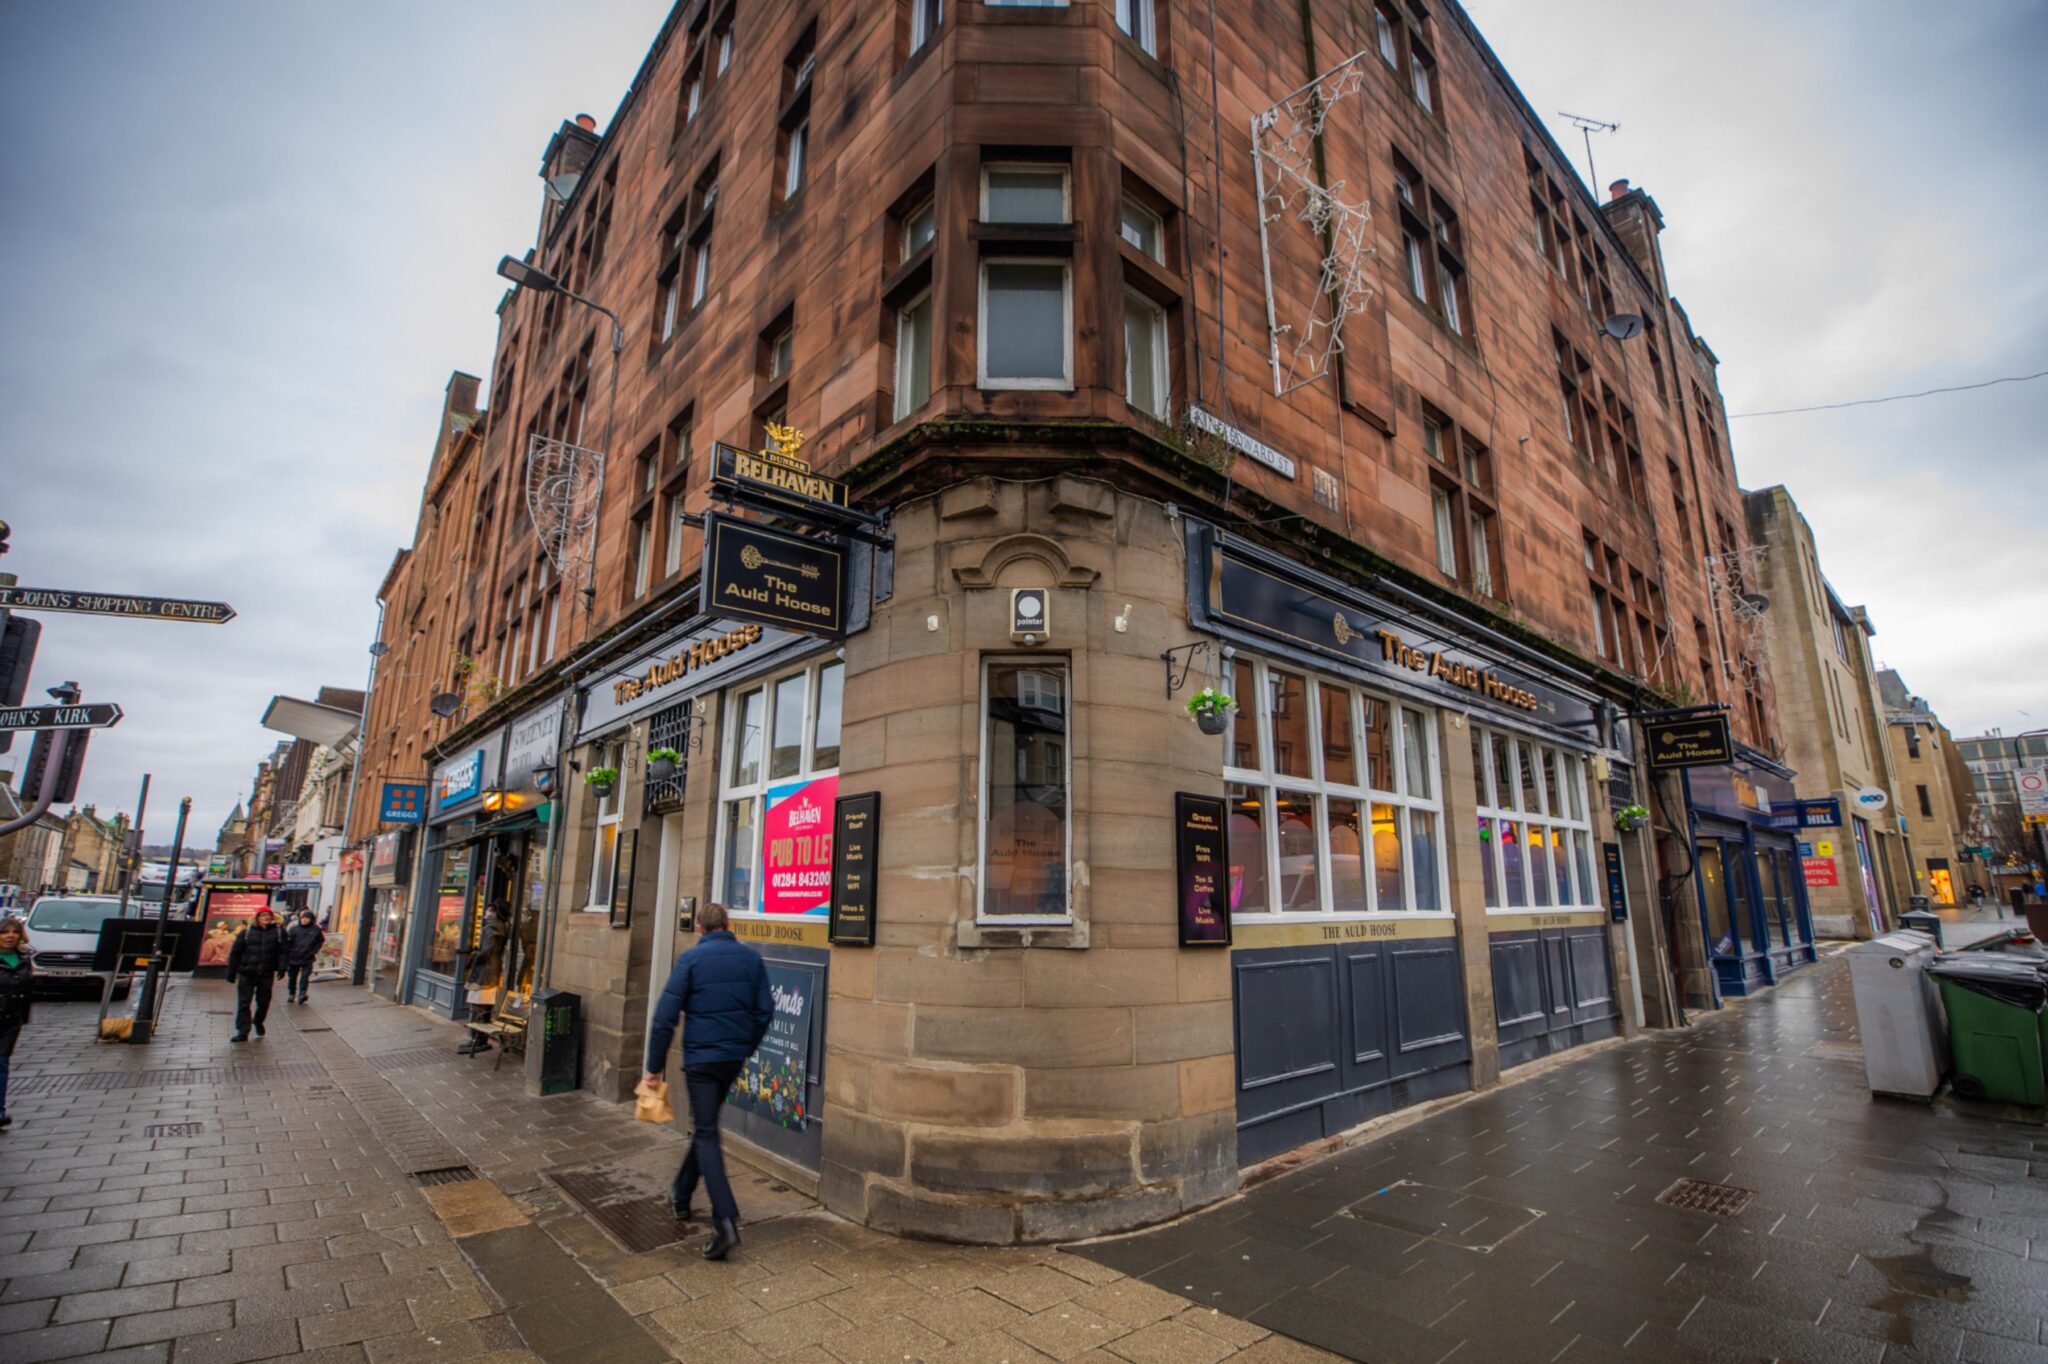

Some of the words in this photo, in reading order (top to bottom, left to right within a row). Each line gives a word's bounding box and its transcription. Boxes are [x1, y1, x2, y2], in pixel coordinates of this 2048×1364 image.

[1230, 428, 1275, 464] EDWARD
[1278, 457, 1289, 473] ST
[769, 453, 806, 471] DUNBAR
[735, 453, 834, 503] BELHAVEN
[763, 574, 798, 593] The
[0, 590, 11, 603] T
[15, 591, 71, 608] JOHN'S
[77, 595, 151, 613] SHOPPING
[160, 601, 223, 618] CENTRE
[724, 583, 769, 603] Auld
[775, 593, 831, 616] Hoose
[1016, 618, 1044, 627] pointer
[613, 677, 642, 705] The
[643, 648, 687, 691] Auld
[689, 623, 762, 670] Hoose
[1376, 628, 1425, 672] The
[1429, 651, 1480, 691] Auld
[1482, 669, 1537, 711] Hoose
[54, 707, 92, 724] KIRK
[1657, 751, 1683, 760] Auld
[1686, 748, 1722, 758] Hoose
[1677, 742, 1699, 750] The
[385, 810, 419, 819] GREGGS
[788, 806, 822, 828] BELHAVEN
[1807, 814, 1834, 824] HILL
[769, 837, 794, 868] PUB
[796, 835, 812, 866] TO
[1015, 839, 1037, 847] The
[734, 923, 748, 936] THE
[751, 924, 771, 937] AULD
[774, 926, 804, 941] HOOSE
[1323, 926, 1341, 939] THE
[1344, 924, 1367, 937] AULD
[1370, 923, 1397, 936] HOOSE
[769, 1019, 795, 1035] MILY
